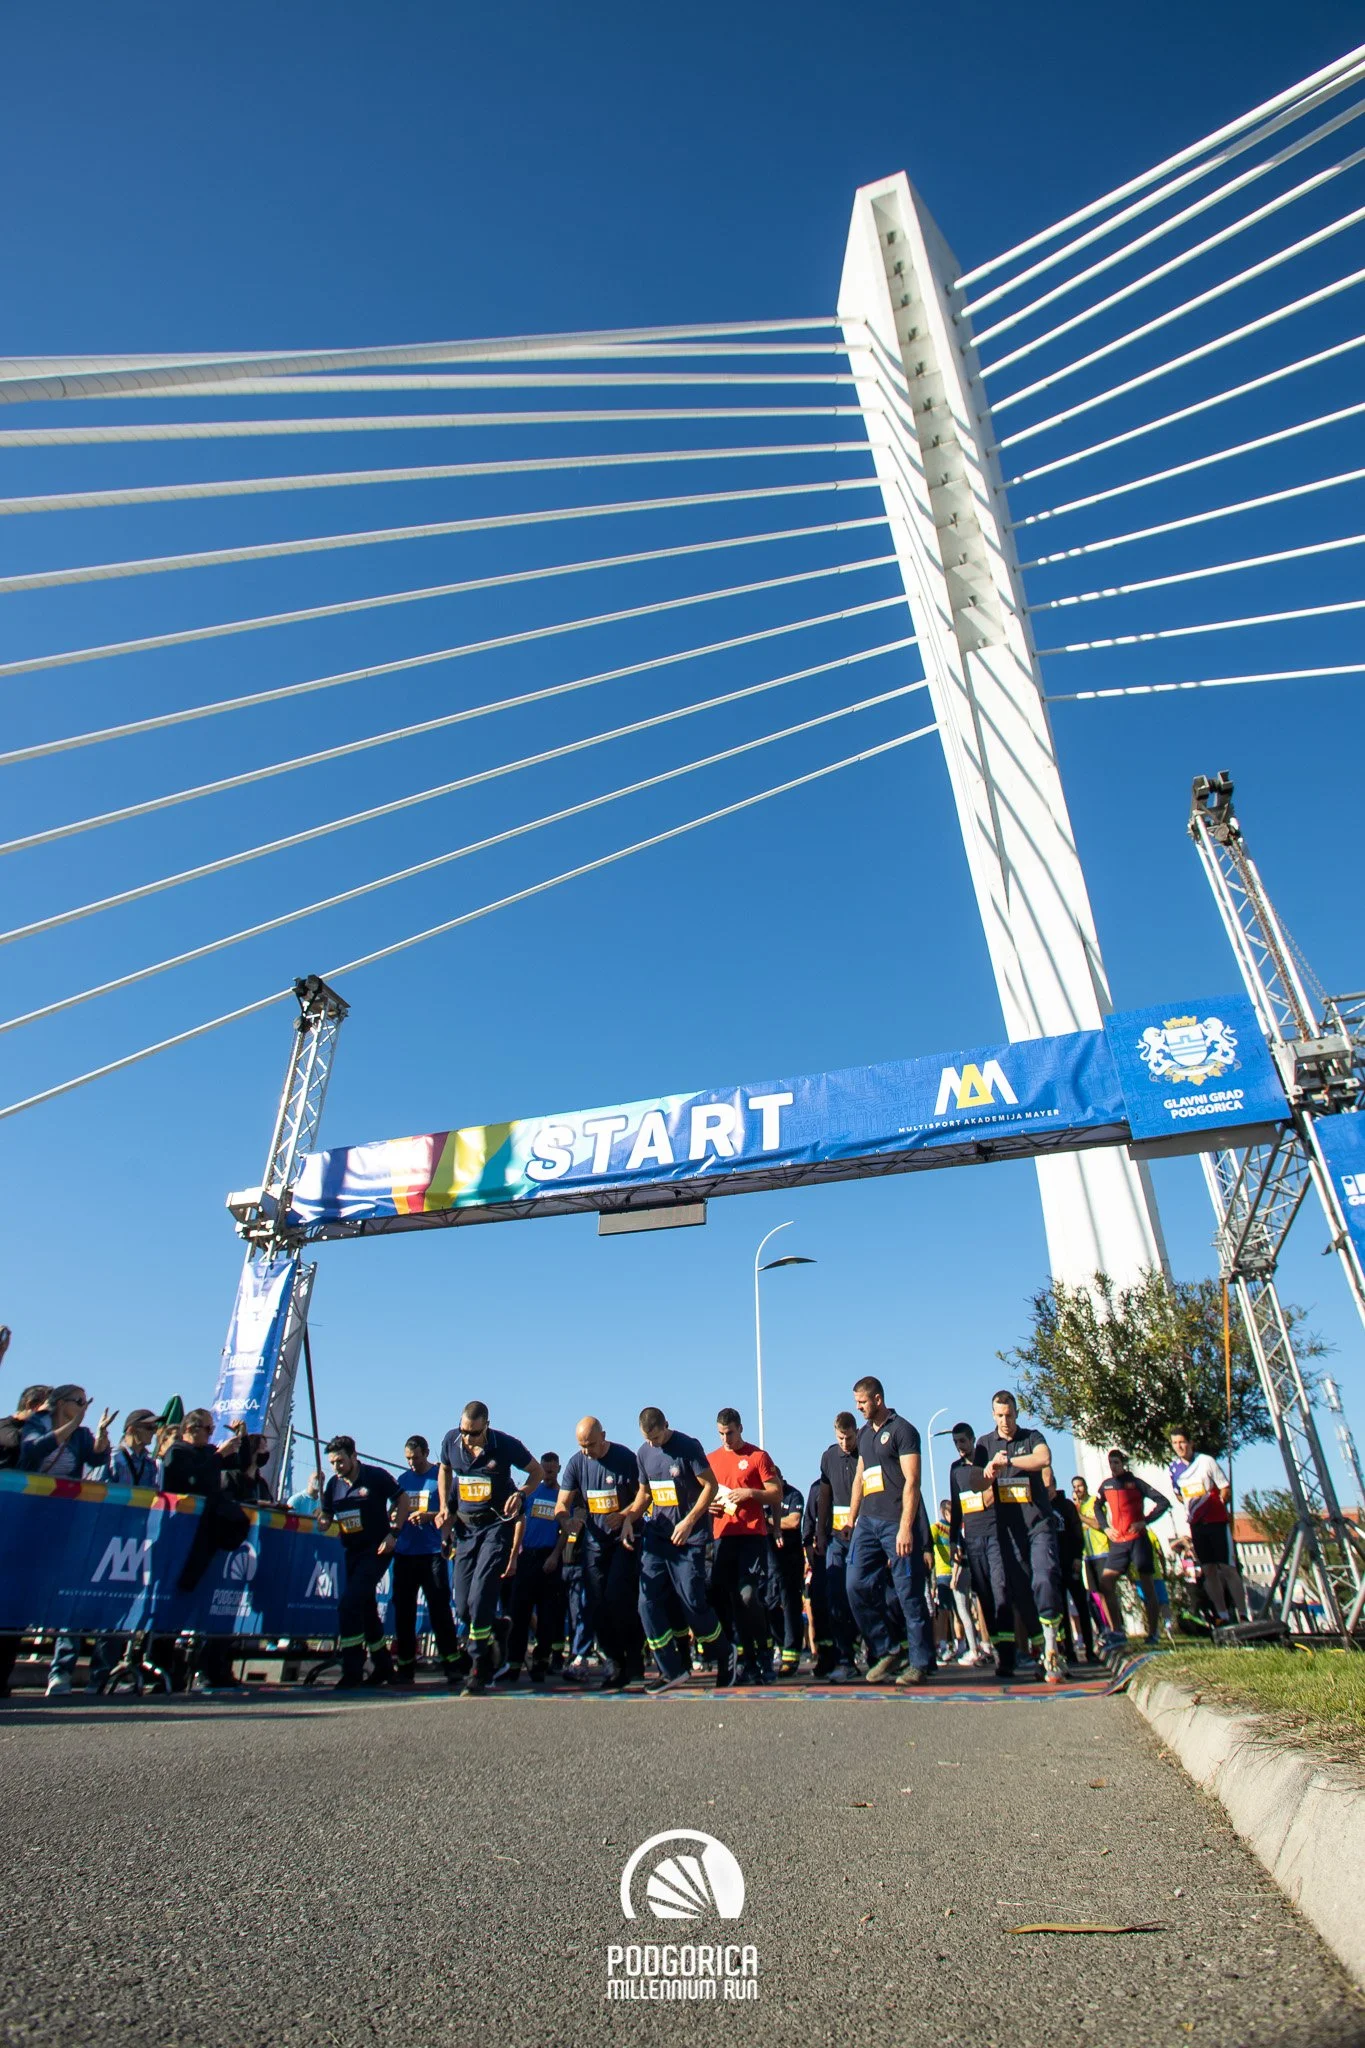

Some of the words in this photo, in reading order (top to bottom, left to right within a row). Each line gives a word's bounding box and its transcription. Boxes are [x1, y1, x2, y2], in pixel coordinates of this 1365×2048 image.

[1164, 1095, 1207, 1110] GLAVNI
[1209, 1089, 1244, 1103] GRAD
[1171, 1100, 1244, 1120] PODGORICA
[898, 1119, 961, 1134] MULTISPORT
[964, 1114, 1022, 1125] AKADEMIJA
[1025, 1109, 1060, 1119] MAYER
[526, 1092, 794, 1182] START
